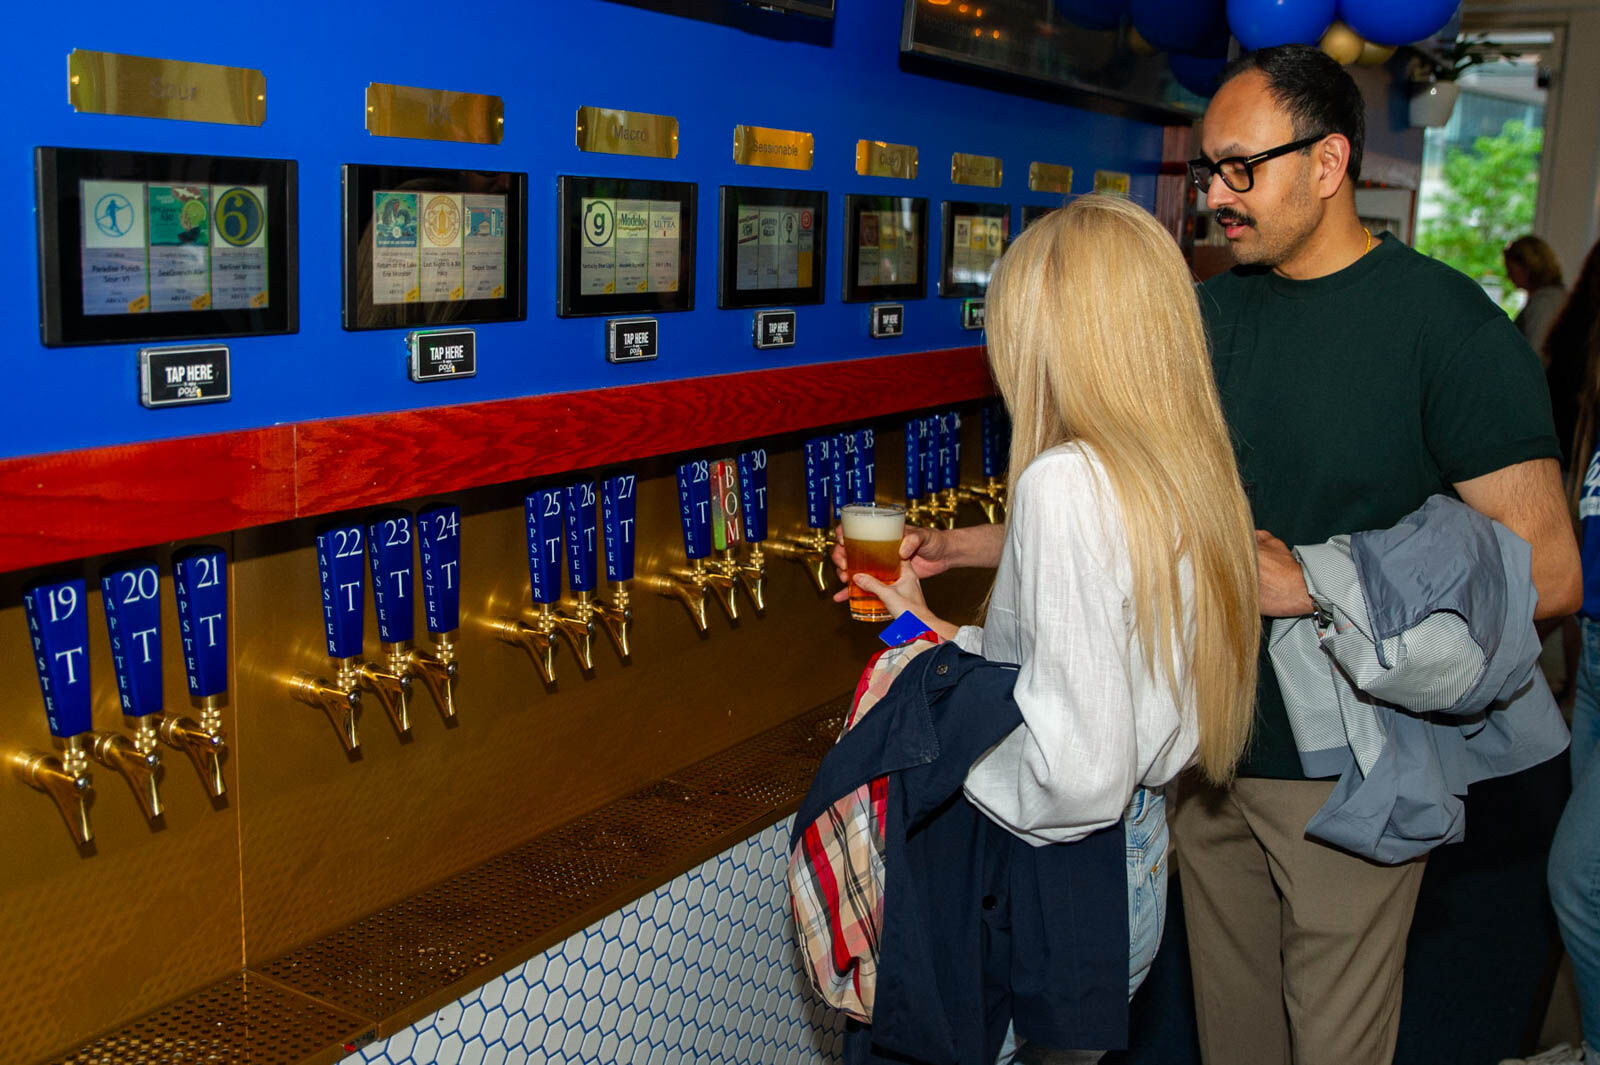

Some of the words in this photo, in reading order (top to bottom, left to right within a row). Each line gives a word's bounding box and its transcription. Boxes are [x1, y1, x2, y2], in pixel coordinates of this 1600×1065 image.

[151, 77, 198, 101] Sour
[614, 125, 648, 142] Macro
[753, 139, 799, 157] Sessionable
[593, 213, 605, 236] g
[621, 213, 645, 228] Modelo
[623, 332, 635, 345] TAP
[634, 331, 649, 344] HERE
[768, 322, 777, 334] TAP
[777, 321, 789, 333] HERE
[430, 346, 444, 361] TAP
[445, 344, 464, 359] HERE
[165, 365, 185, 384] TAP
[186, 363, 213, 381] HERE
[863, 429, 874, 449] 33
[919, 420, 927, 439] 34
[820, 440, 829, 461] 31
[844, 434, 855, 455] 32
[691, 459, 709, 483] 28
[751, 448, 767, 471] 30
[919, 453, 926, 472] T
[617, 475, 635, 499] 27
[806, 444, 817, 524] TAPSTER
[820, 476, 830, 497] T
[846, 469, 854, 490] T
[865, 463, 874, 484] T
[543, 491, 561, 517] 25
[581, 481, 596, 508] 26
[725, 465, 740, 543] BOM
[741, 453, 754, 537] TAPSTER
[755, 486, 766, 509] T
[680, 465, 695, 554] TAPSTER
[696, 500, 709, 524] T
[384, 517, 411, 547] 23
[435, 511, 460, 541] 24
[567, 486, 582, 584] TAPSTER
[584, 526, 595, 552] T
[603, 480, 616, 576] TAPSTER
[620, 518, 634, 543] T
[334, 528, 363, 558] 22
[527, 497, 541, 599] TAPSTER
[546, 536, 560, 564] T
[195, 555, 220, 589] 21
[370, 525, 389, 637] TAPSTER
[390, 568, 410, 598] T
[420, 521, 438, 628] TAPSTER
[441, 560, 457, 589] T
[120, 568, 159, 604] 20
[317, 536, 337, 653] TAPSTER
[340, 581, 360, 612] T
[48, 586, 77, 622] 19
[176, 562, 198, 689] TAPSTER
[199, 613, 222, 647] T
[102, 577, 131, 708] TAPSTER
[132, 627, 157, 664] T
[25, 595, 58, 731] TAPSTER
[55, 646, 83, 685] T
